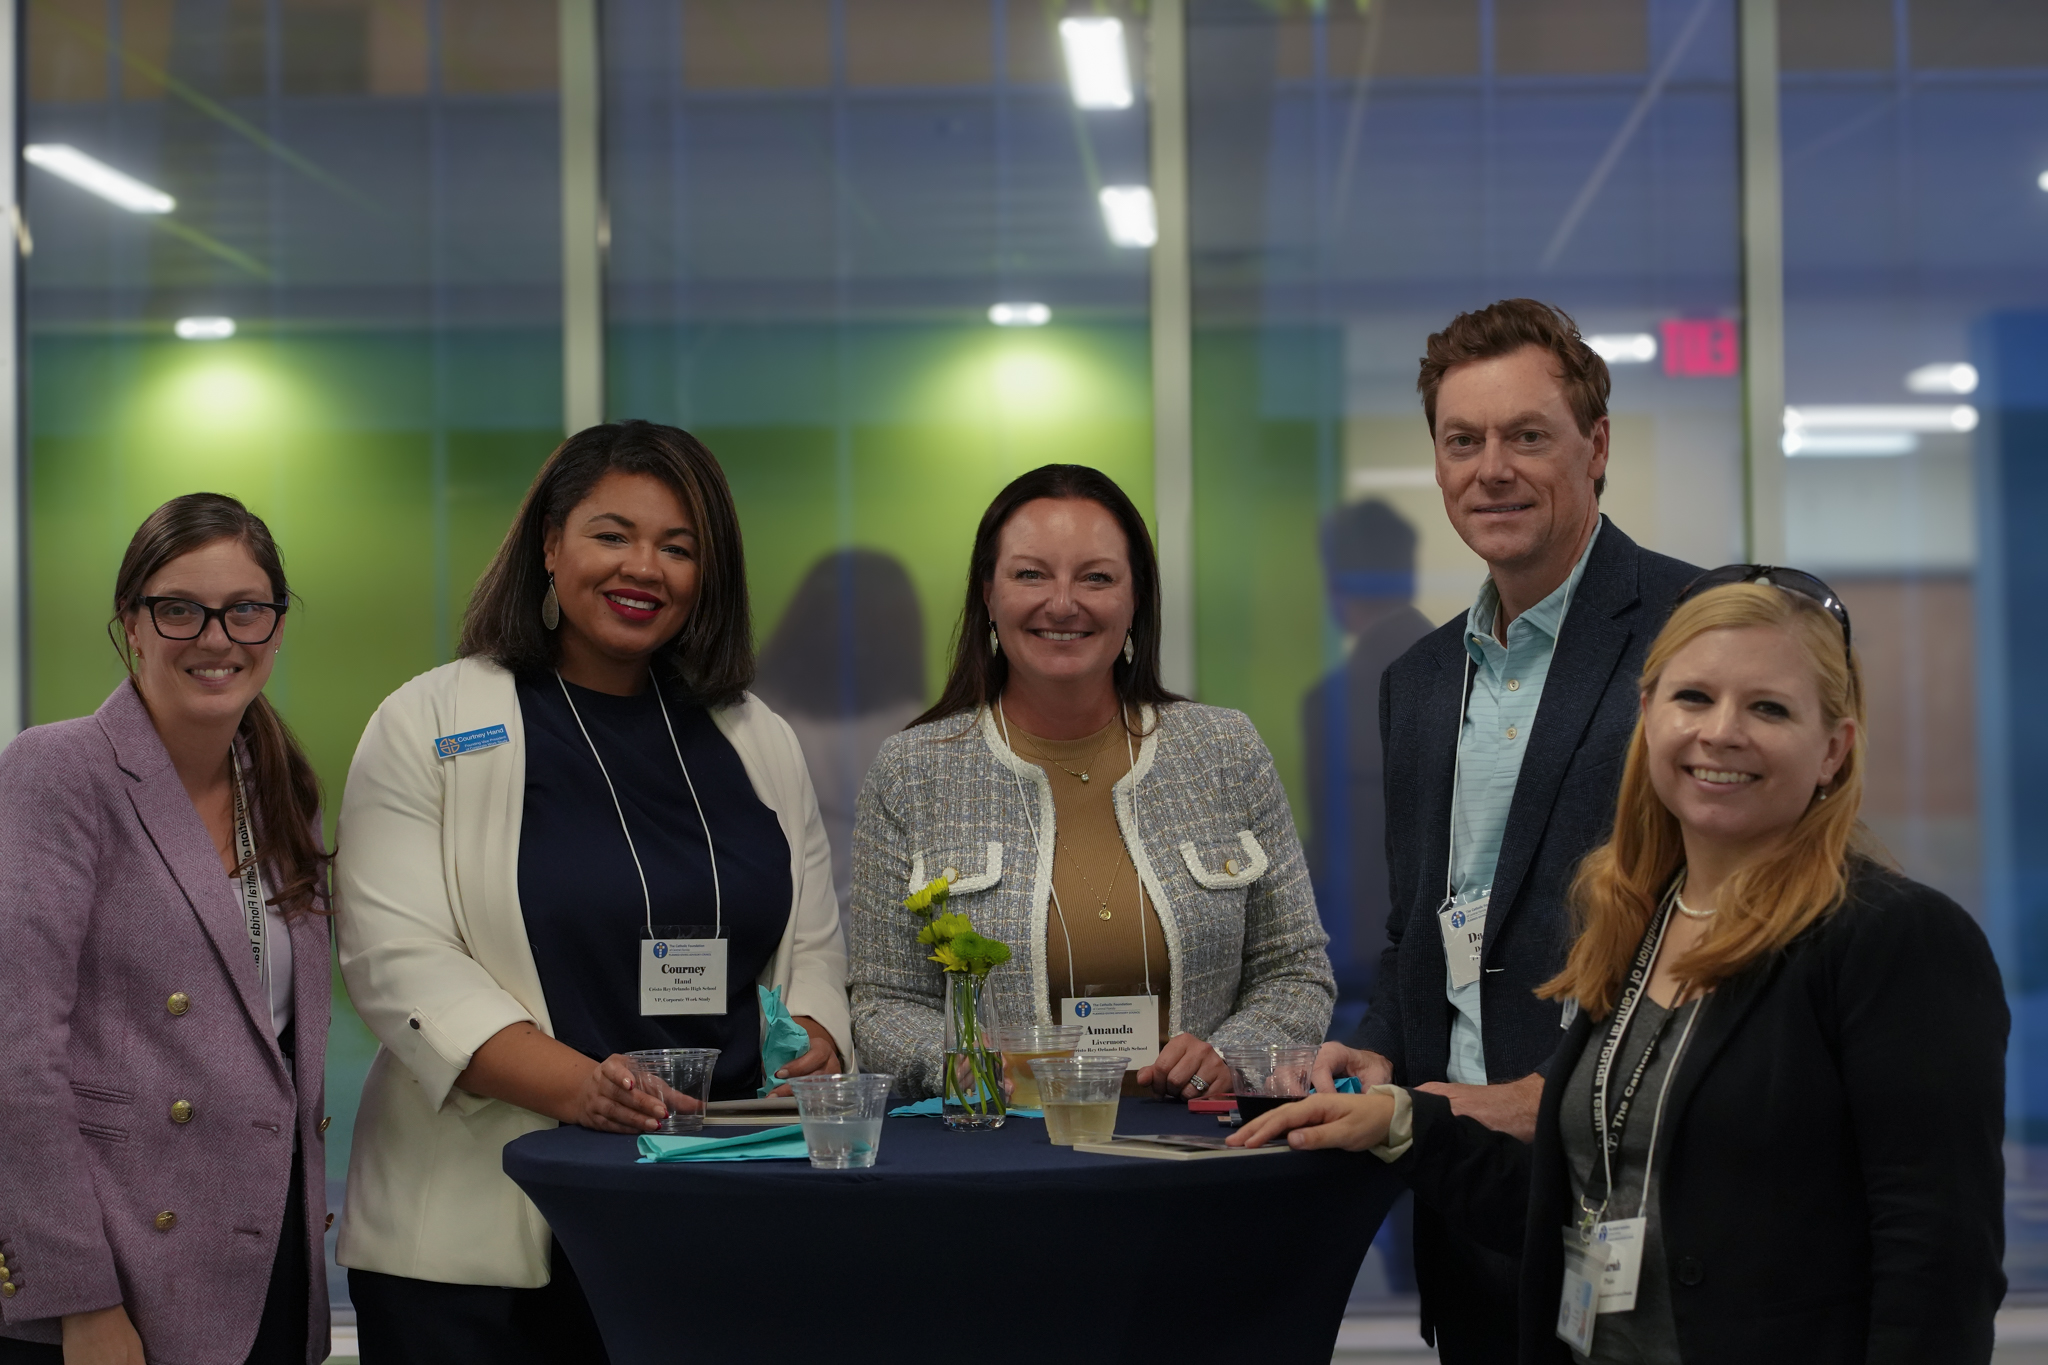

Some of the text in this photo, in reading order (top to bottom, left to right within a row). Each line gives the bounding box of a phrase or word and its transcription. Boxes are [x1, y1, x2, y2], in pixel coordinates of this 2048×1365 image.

[457, 727, 504, 743] Courtney Hand
[661, 963, 706, 976] Courney
[1629, 969, 1643, 986] of
[1610, 987, 1638, 1037] Central
[1084, 1024, 1133, 1035] Amanda
[1595, 1039, 1617, 1086] Florida
[1611, 1100, 1629, 1128] The
